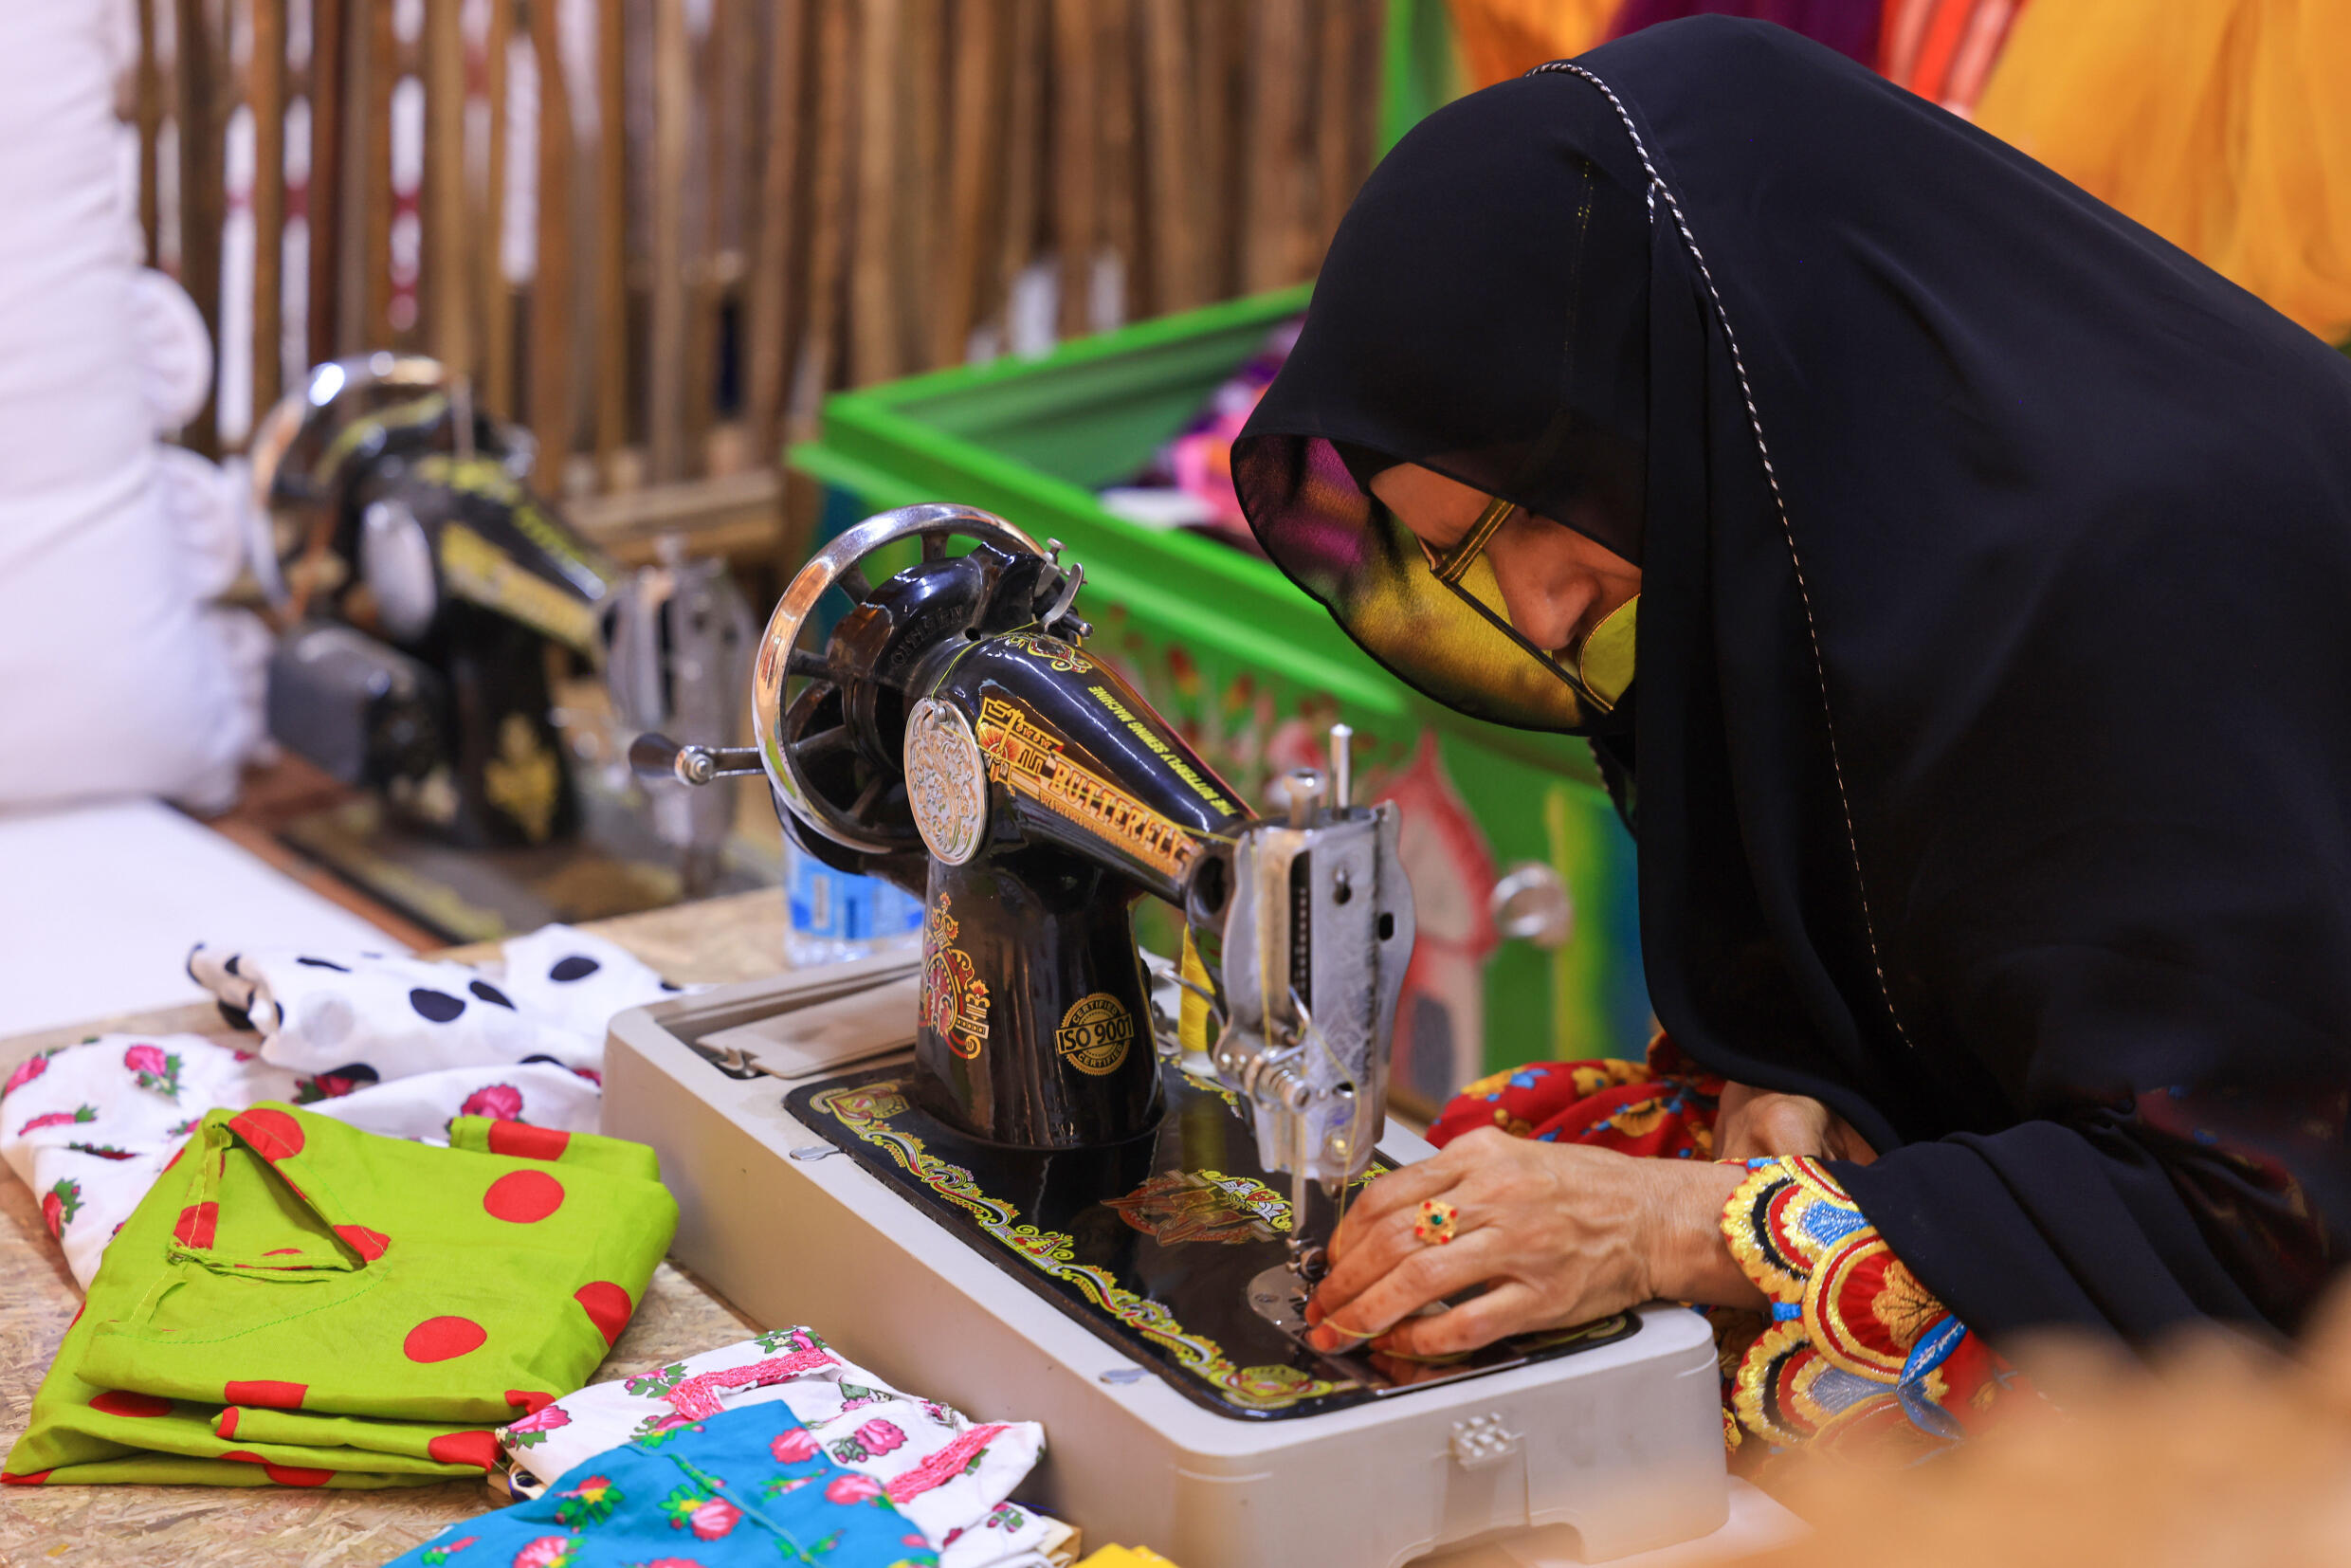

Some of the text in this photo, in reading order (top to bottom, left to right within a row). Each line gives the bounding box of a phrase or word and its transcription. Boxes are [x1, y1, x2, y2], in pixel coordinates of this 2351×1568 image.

[1087, 685, 1136, 721] MACHINE
[1127, 722, 1170, 754] SEWING
[1160, 755, 1220, 800] BUTTERFLY
[1048, 761, 1190, 862] BUTTERFLY
[1072, 1000, 1118, 1024] CERTIFIED
[1058, 1017, 1132, 1051] ISO 9001
[1078, 1044, 1122, 1067] CERTIFIED
